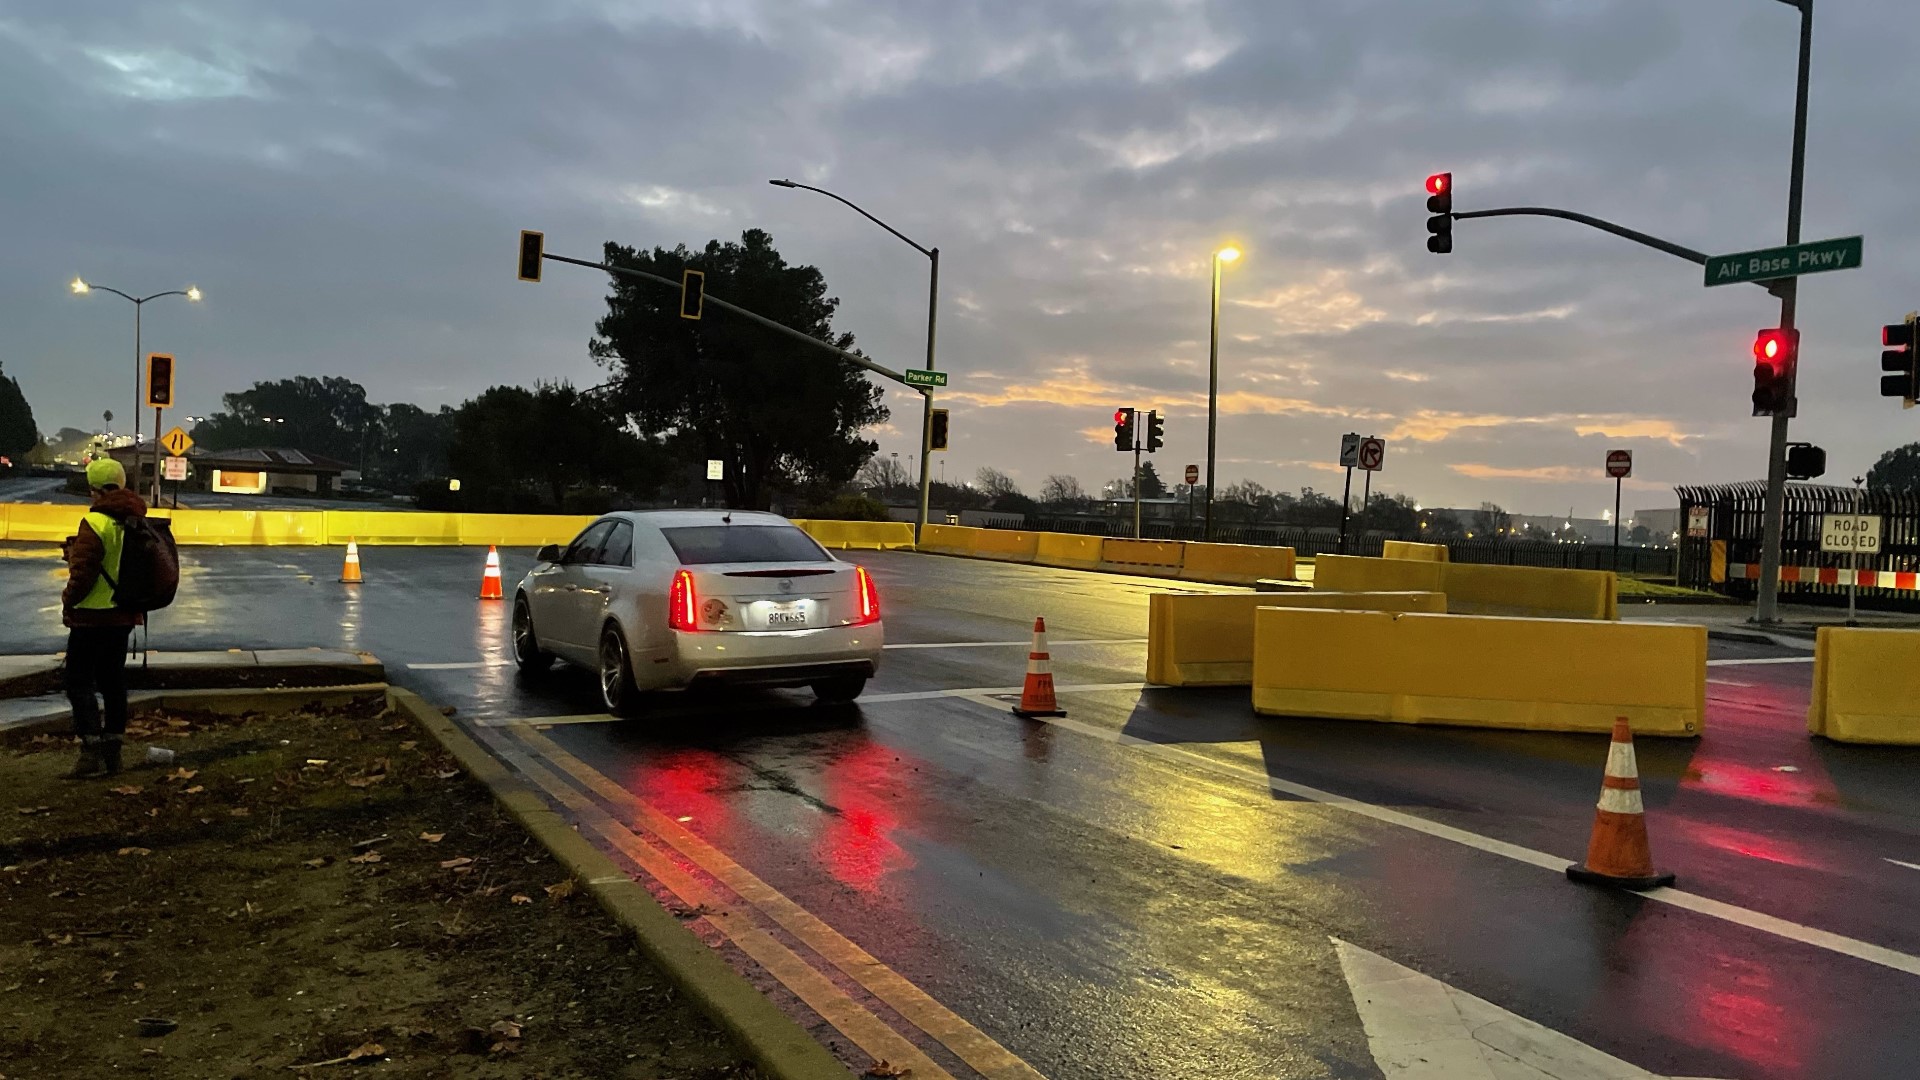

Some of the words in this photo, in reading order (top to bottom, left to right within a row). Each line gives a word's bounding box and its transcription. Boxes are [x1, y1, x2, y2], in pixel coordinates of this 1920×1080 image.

[1718, 263, 1743, 278] Air
[1749, 257, 1790, 274] Base
[1798, 248, 1848, 267] Pkwy
[908, 372, 933, 382] Parker
[935, 375, 945, 384] Rd
[1834, 520, 1869, 532] ROAD
[1825, 534, 1877, 548] CLOSED
